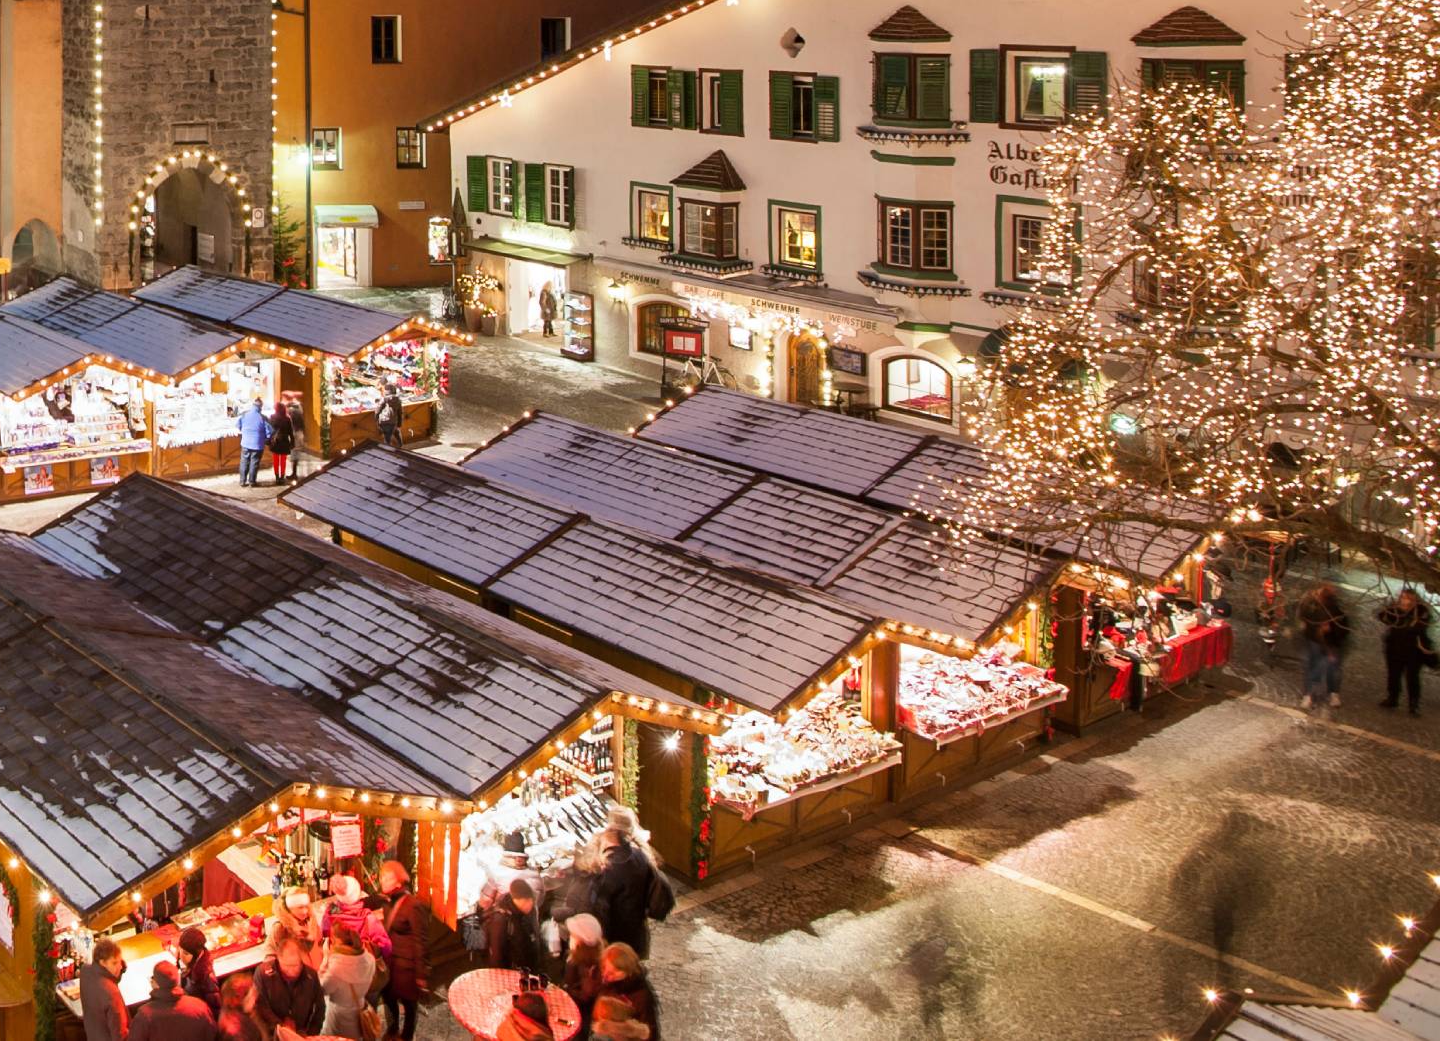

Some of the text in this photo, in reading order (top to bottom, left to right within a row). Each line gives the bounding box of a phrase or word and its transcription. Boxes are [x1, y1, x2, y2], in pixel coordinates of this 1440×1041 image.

[988, 140, 1058, 165] Albe
[990, 165, 1080, 195] Gastf
[620, 271, 660, 285] SCHWEMME
[684, 285, 698, 294] BAR
[751, 298, 800, 314] SCHWEMME
[829, 314, 877, 331] WEINSTUBE
